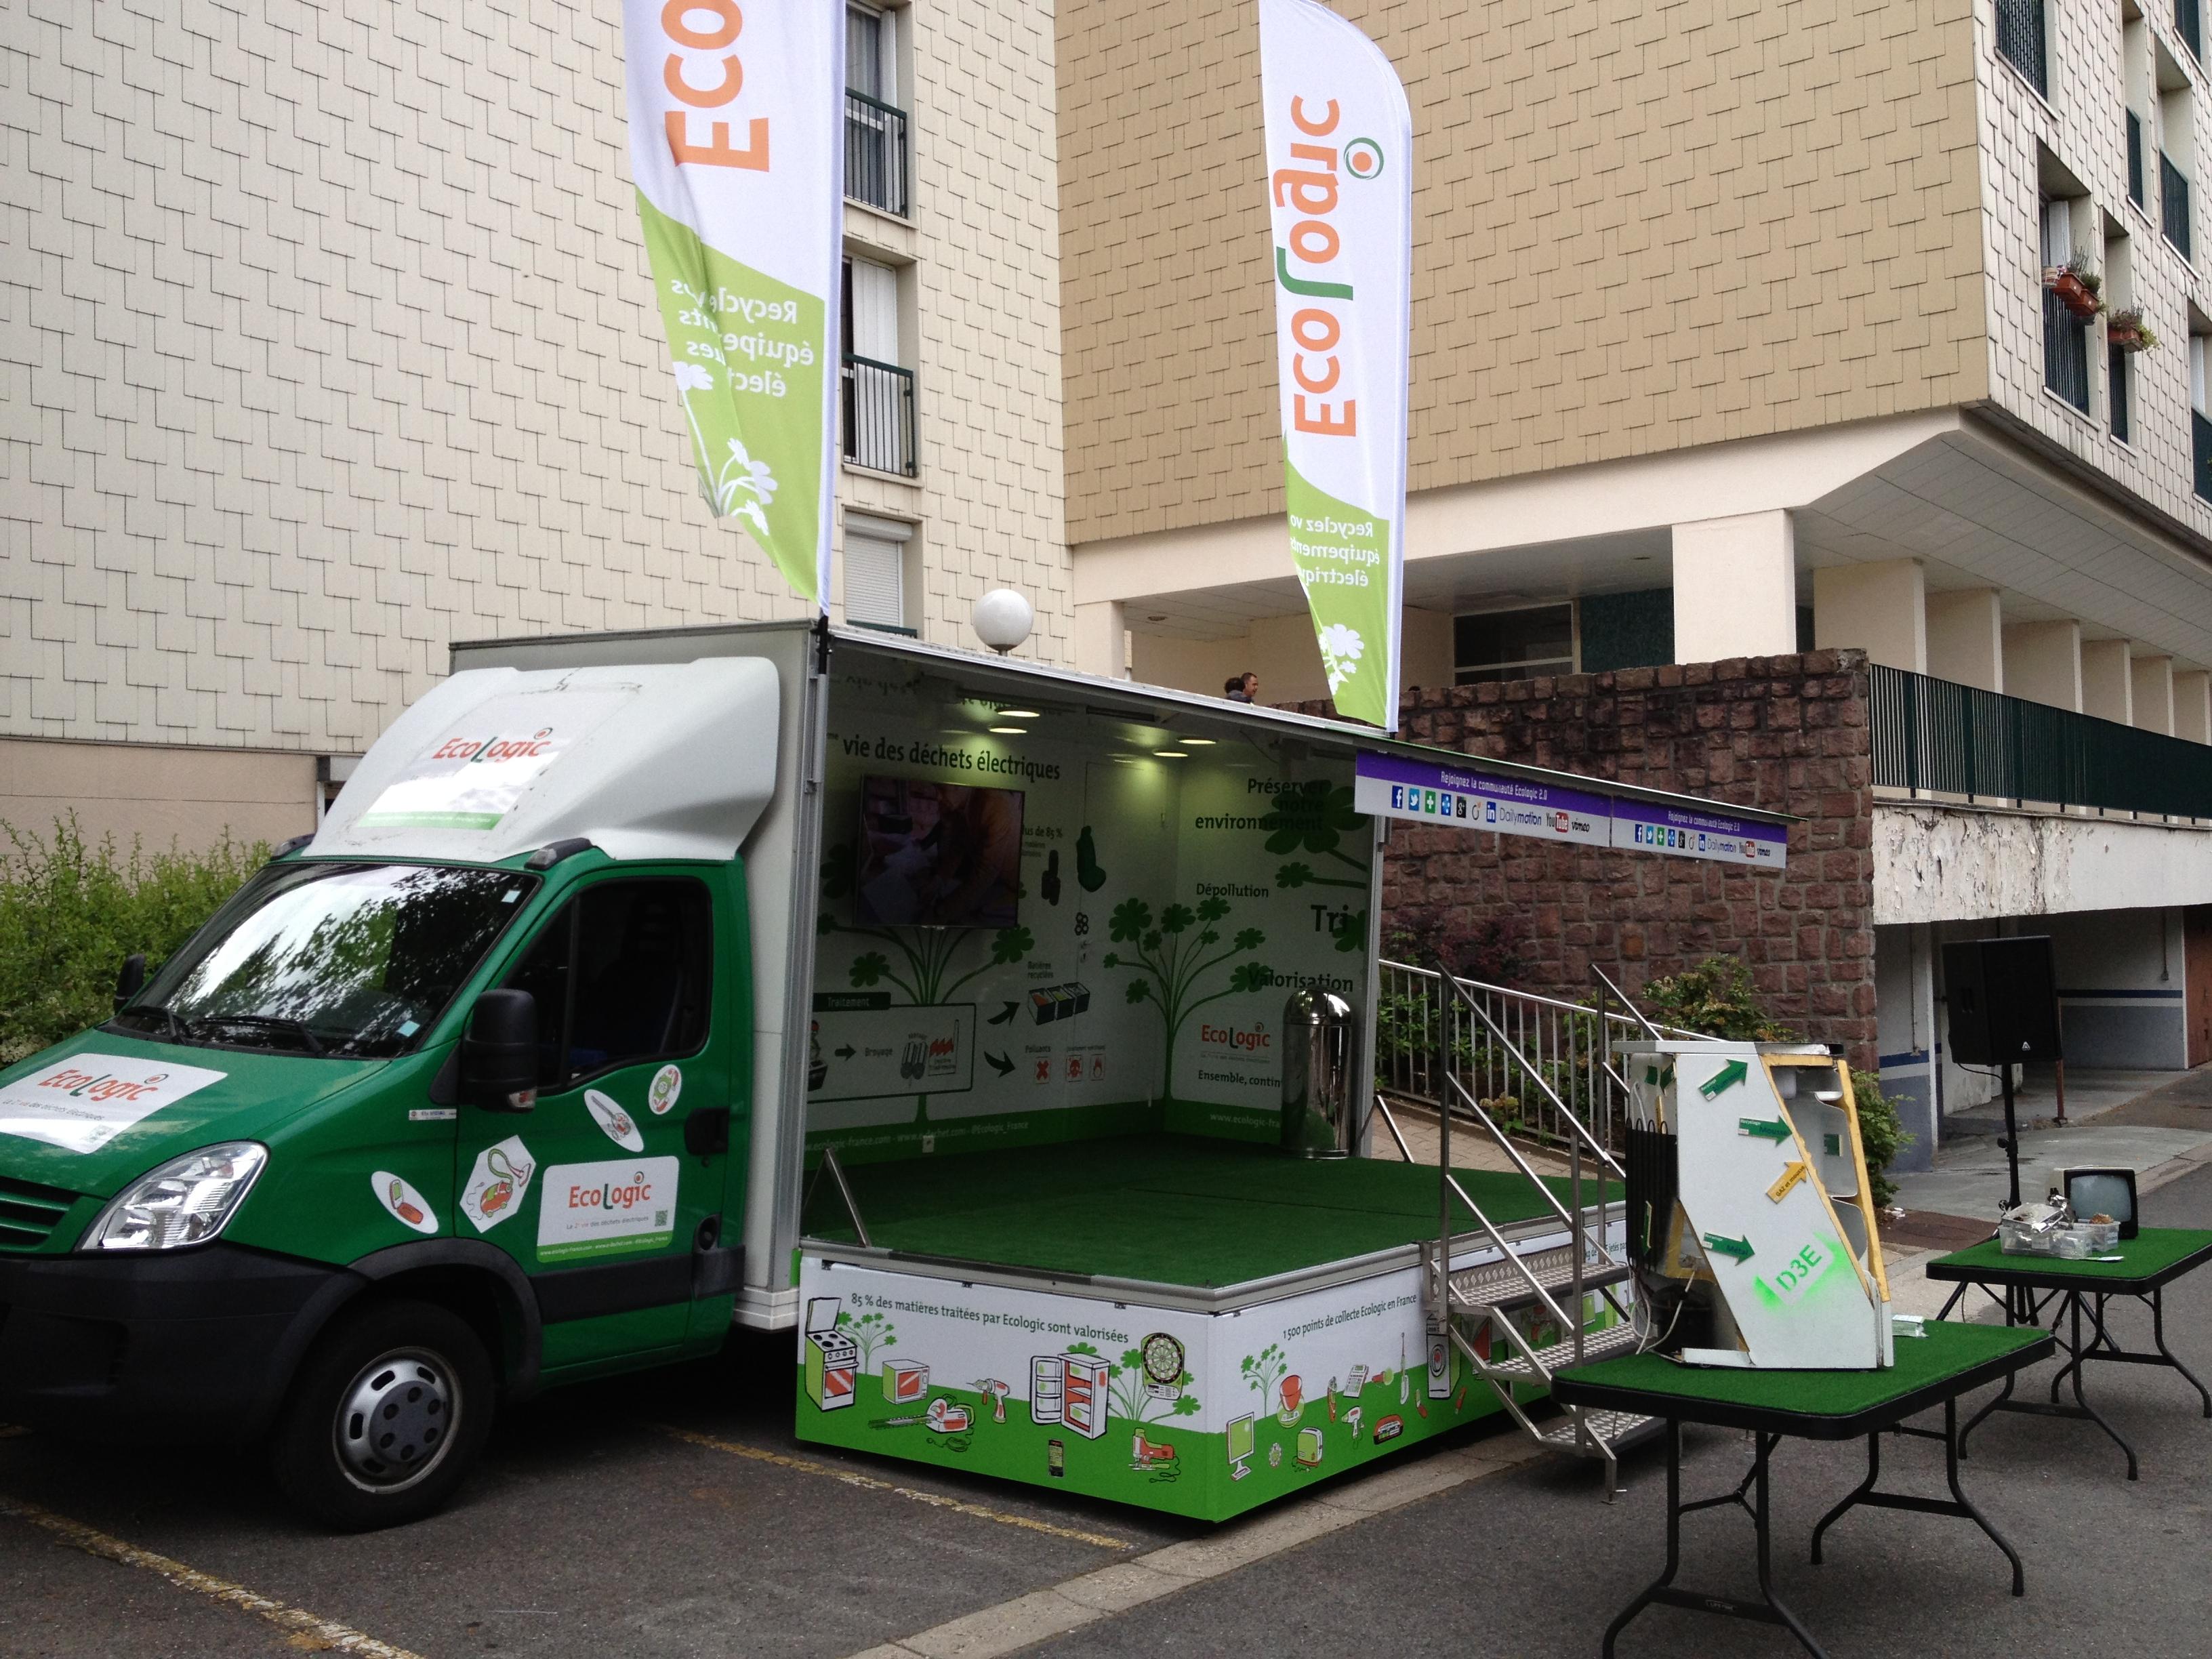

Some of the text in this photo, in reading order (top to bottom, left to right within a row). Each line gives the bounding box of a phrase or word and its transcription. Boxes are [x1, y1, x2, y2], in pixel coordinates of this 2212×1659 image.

[844, 735, 871, 758] vie
[875, 737, 904, 761] des
[909, 741, 972, 770] déchets
[977, 750, 1061, 783] électriques
[1441, 771, 1469, 788] Rejoignez
[1471, 777, 1477, 789] la
[1515, 785, 1538, 801] Ecologic
[1538, 789, 1548, 800] 2.0
[1499, 807, 1542, 825] Dailymotion
[1546, 813, 1569, 831] YouTube
[1196, 883, 1269, 899] Dépollution
[1311, 905, 1349, 933] Tri
[827, 996, 870, 1008] Traitement
[1198, 1069, 1248, 1086] Ensemble,
[1776, 1244, 1824, 1292] D3E
[851, 1292, 1129, 1344] 85 % des matières traitées par Ecologic sont valorisées
[1302, 1318, 1324, 1338] points
[1325, 1315, 1334, 1328] de
[1335, 1309, 1360, 1326] collecte
[1361, 1302, 1387, 1318] Ecologic
[1387, 1299, 1395, 1309] en
[1396, 1293, 1417, 1307] France
